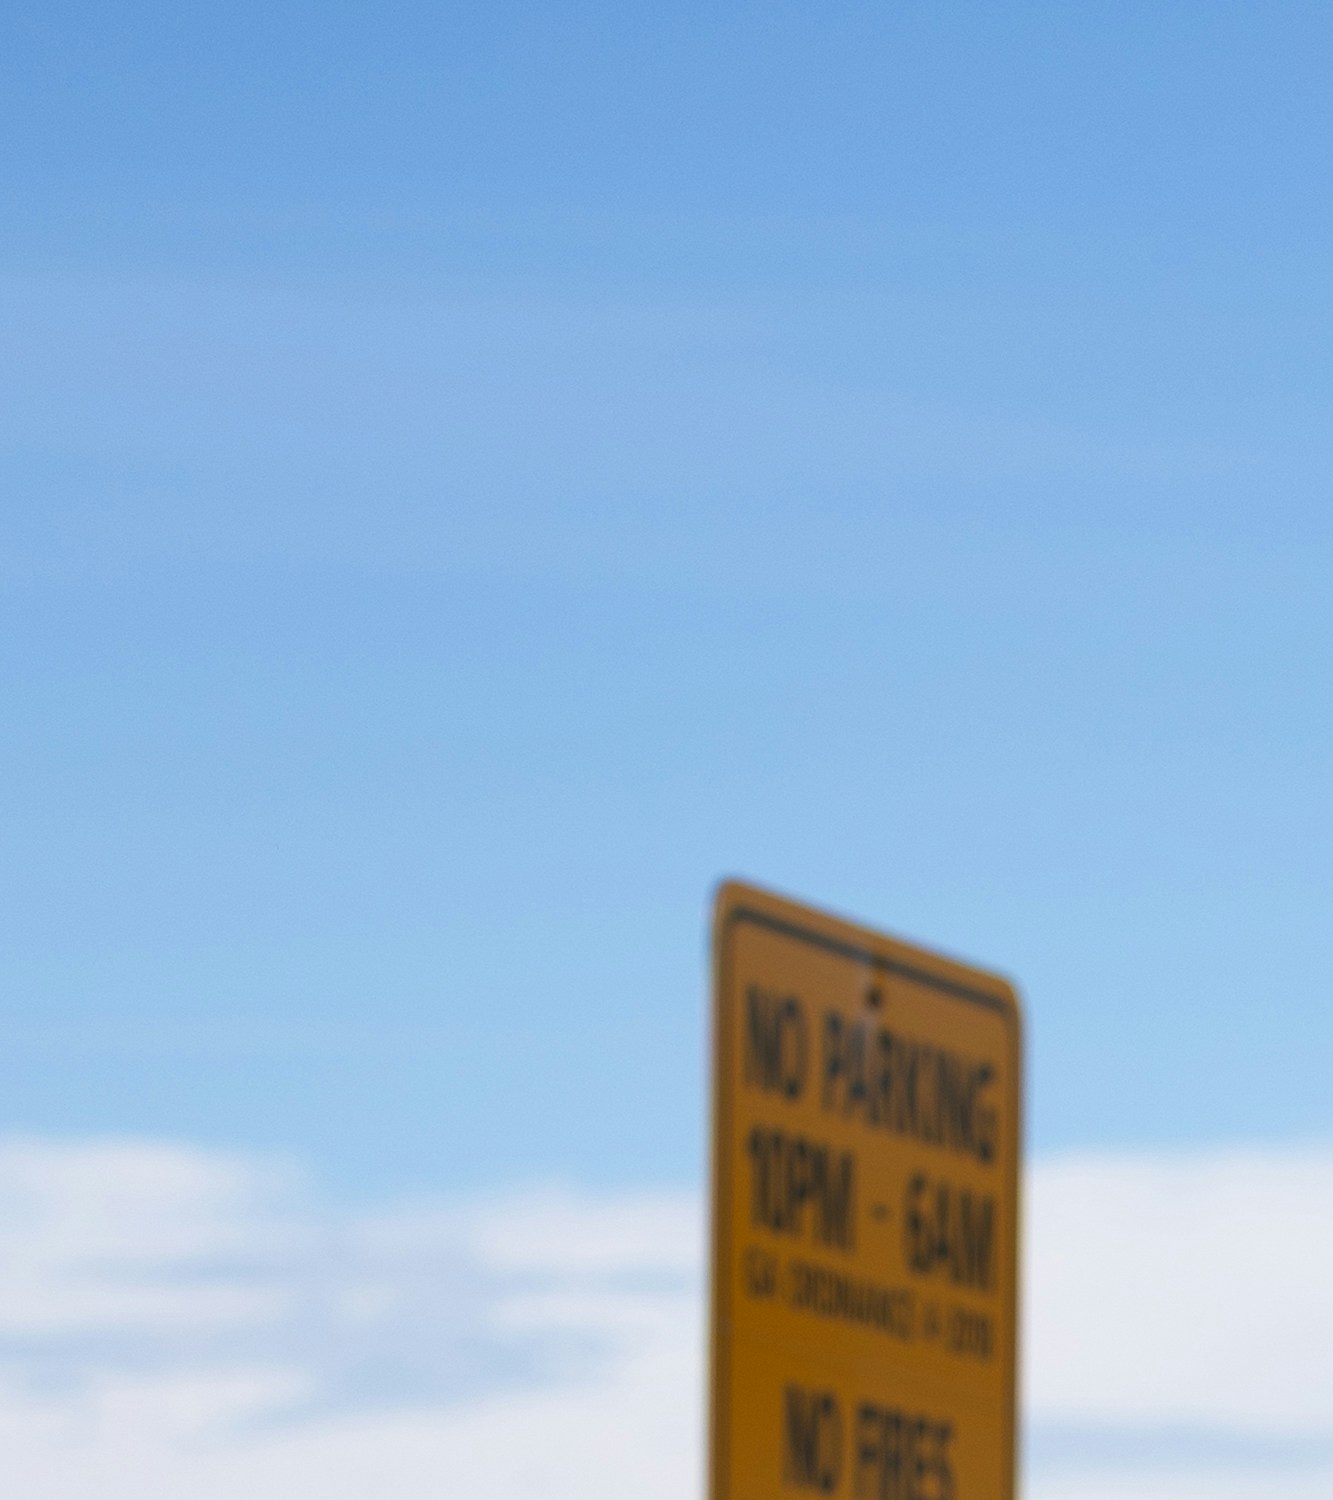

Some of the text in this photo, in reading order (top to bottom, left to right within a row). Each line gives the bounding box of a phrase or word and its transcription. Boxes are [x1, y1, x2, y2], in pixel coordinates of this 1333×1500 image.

[746, 983, 998, 1161] NO PARKING
[748, 1128, 855, 1251] 10PM
[905, 1174, 996, 1291] 6AM
[783, 1384, 842, 1499] NO
